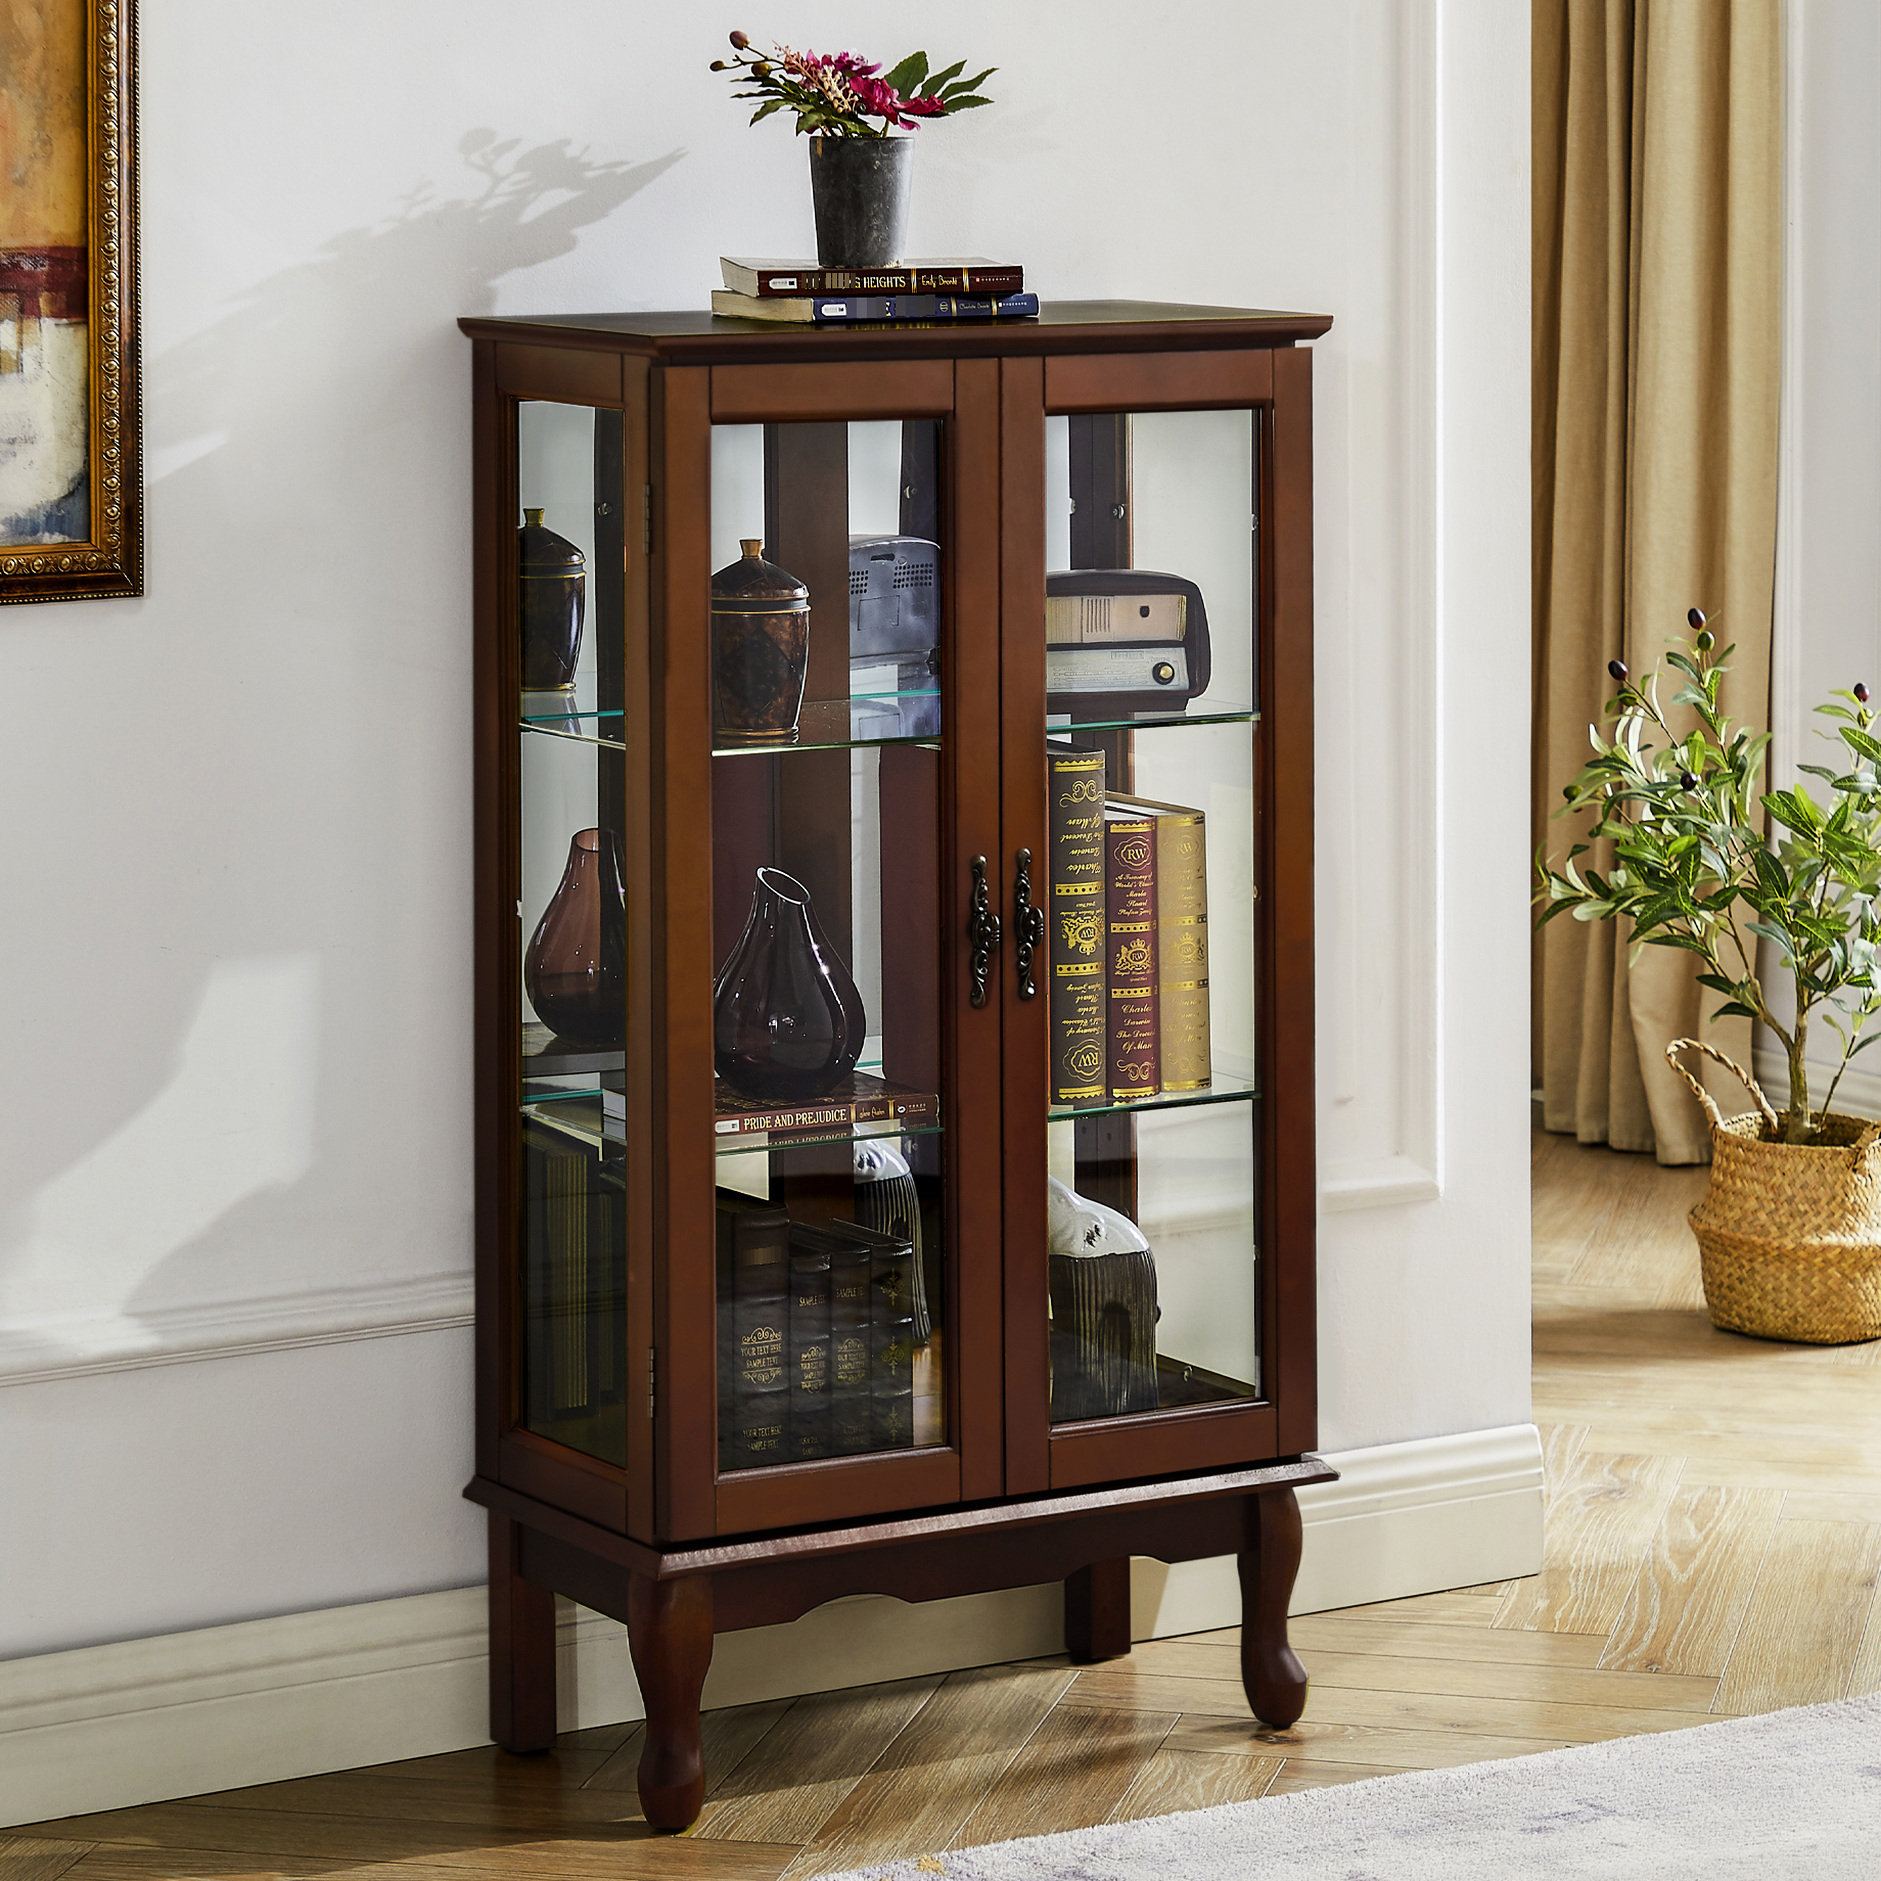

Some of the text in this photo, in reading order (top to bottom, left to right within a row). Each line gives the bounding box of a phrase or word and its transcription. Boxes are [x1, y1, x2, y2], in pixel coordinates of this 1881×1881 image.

[863, 276, 906, 288] HEIGHTS
[1127, 848, 1147, 860] RW
[1078, 1052, 1099, 1067] RW
[743, 1115, 772, 1130] PRIDE
[774, 1113, 794, 1127] AND
[795, 1108, 847, 1125] PREJUDICE
[740, 1346, 757, 1357] YOUR
[746, 1357, 767, 1369] SAMPLE
